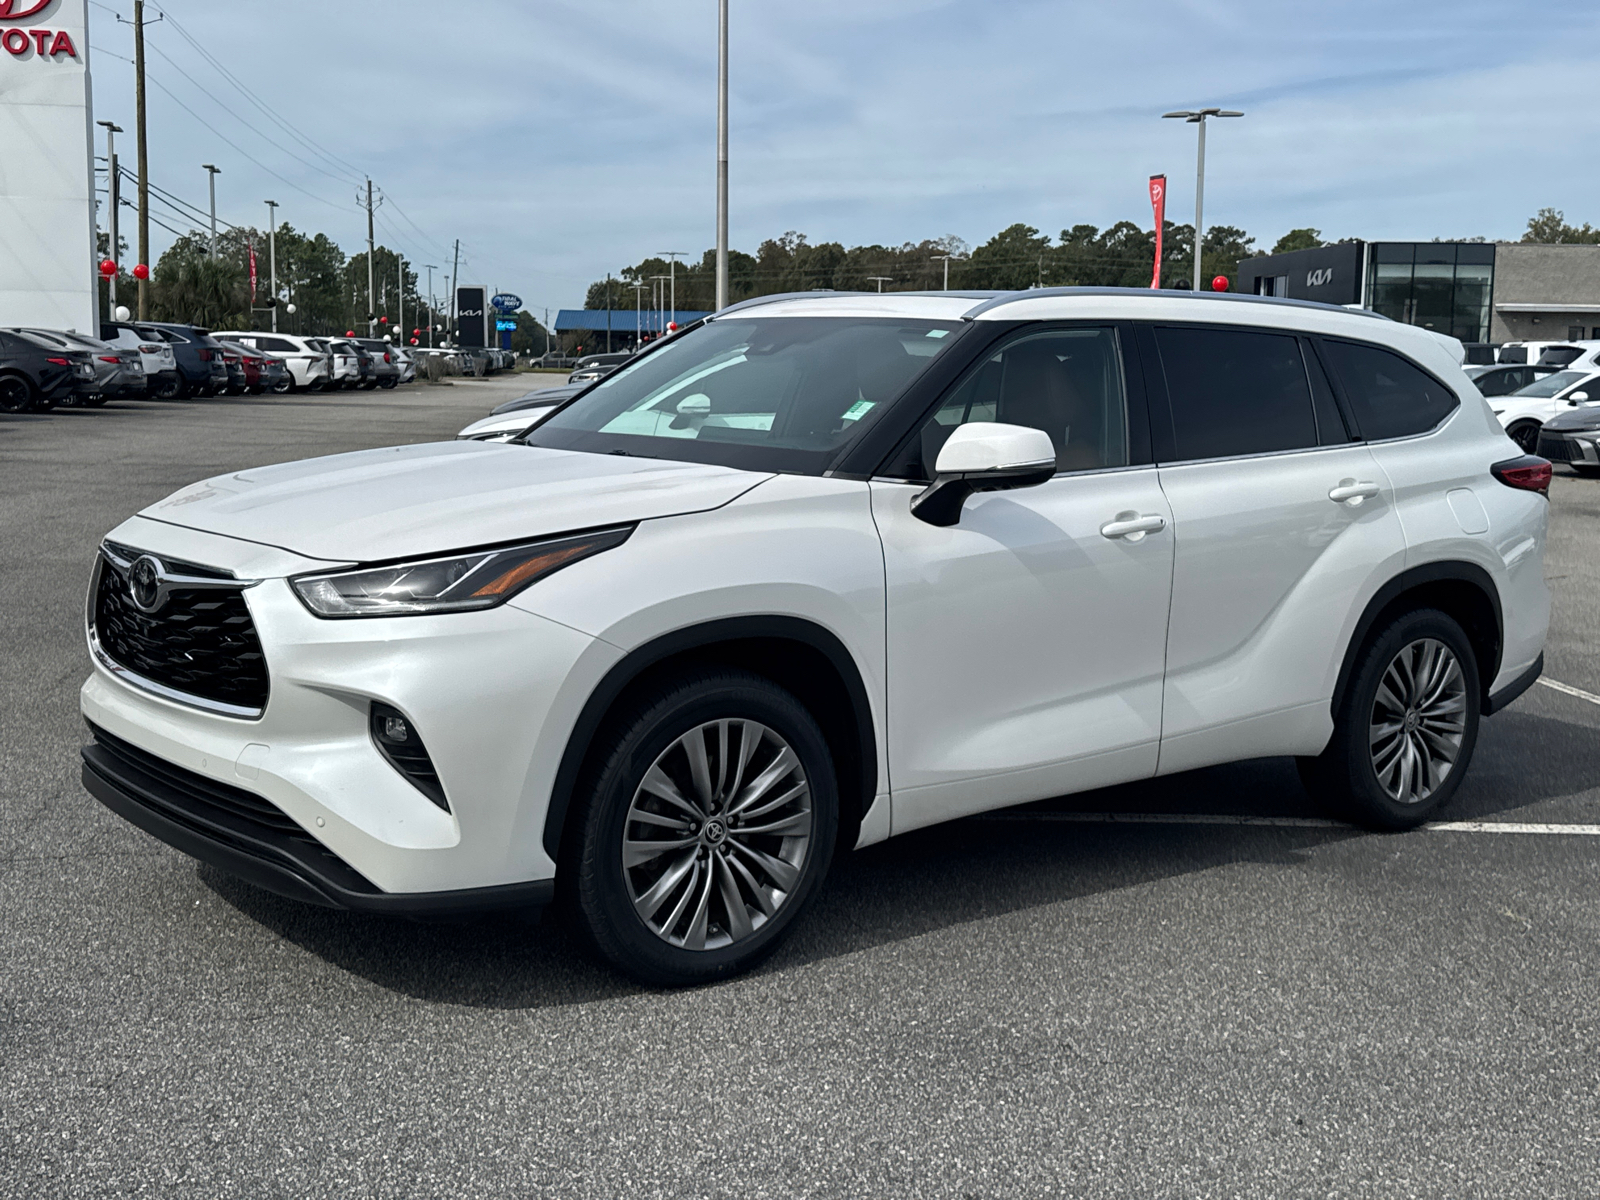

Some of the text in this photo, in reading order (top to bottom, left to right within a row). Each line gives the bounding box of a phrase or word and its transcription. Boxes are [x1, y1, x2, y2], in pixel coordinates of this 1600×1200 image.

[0, 28, 76, 57] OTA
[1306, 267, 1333, 287] KIA
[459, 309, 482, 317] KIA
